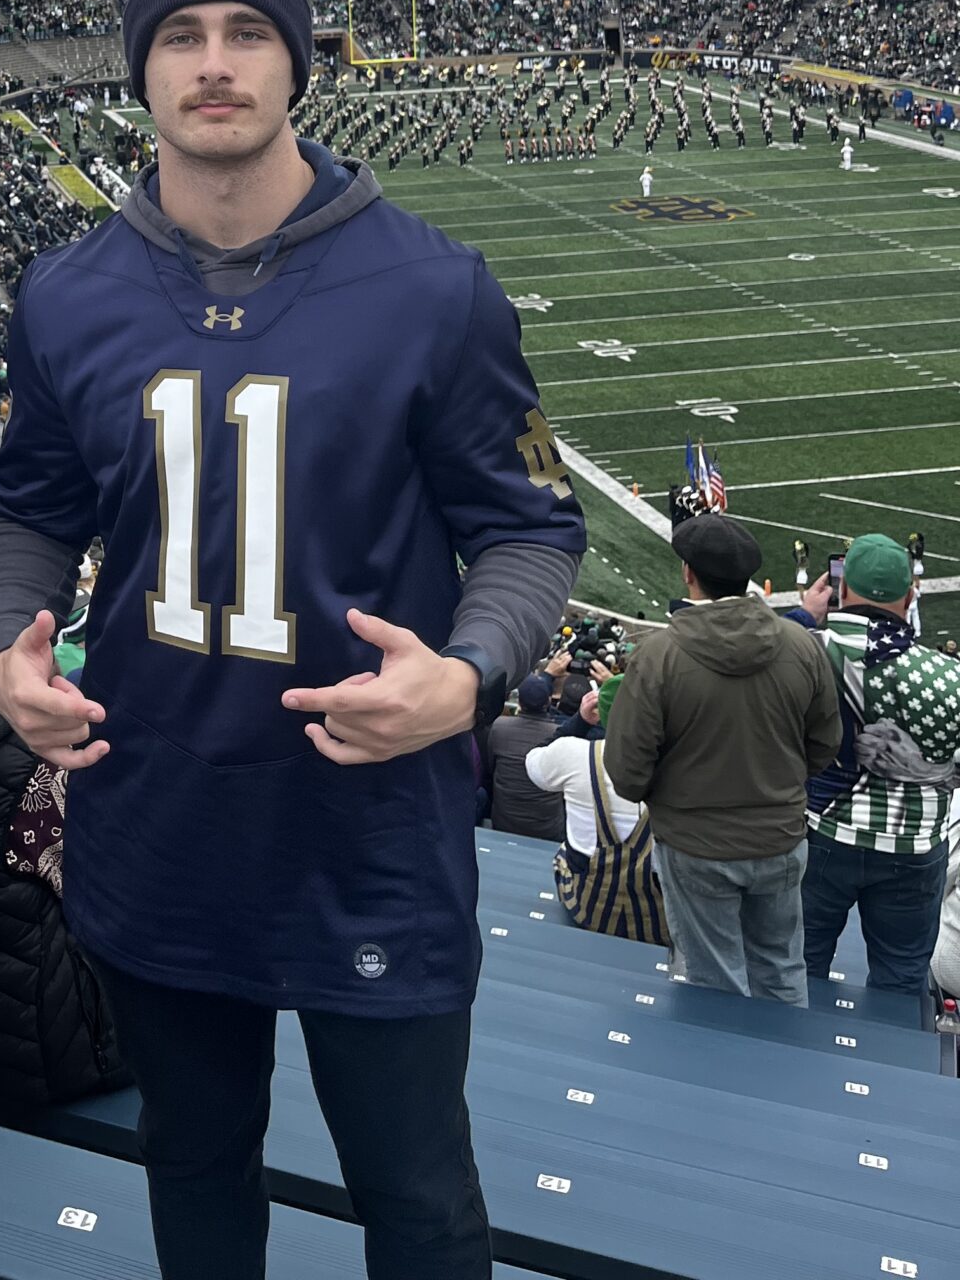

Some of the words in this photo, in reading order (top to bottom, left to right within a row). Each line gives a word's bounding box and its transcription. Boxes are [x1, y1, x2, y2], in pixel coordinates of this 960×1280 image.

[577, 338, 638, 362] 20
[675, 397, 739, 423] 10
[143, 368, 297, 664] 11
[362, 954, 379, 964] MD
[569, 1091, 591, 1102] 12
[863, 1155, 884, 1167] 11
[540, 1176, 566, 1190] 12
[63, 1210, 91, 1227] 13
[887, 1259, 913, 1275] 11
